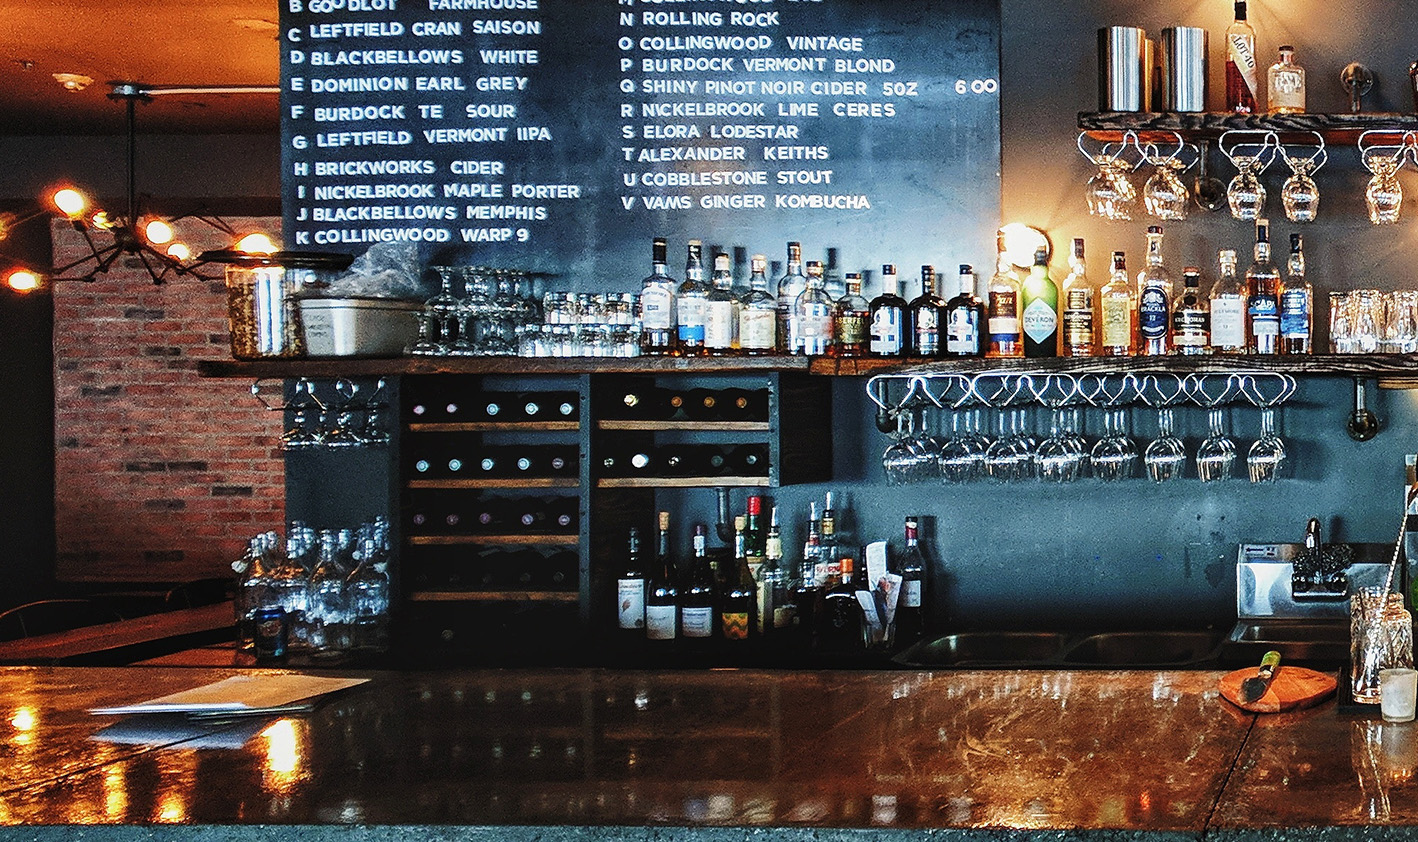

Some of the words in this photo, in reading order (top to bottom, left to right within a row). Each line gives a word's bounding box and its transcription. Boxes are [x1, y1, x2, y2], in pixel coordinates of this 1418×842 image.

[289, 0, 302, 12] B
[428, 0, 538, 11] FARMHOUSE
[619, 12, 633, 27] N
[643, 12, 722, 26] ROLLING
[731, 11, 779, 26] ROCK
[288, 28, 301, 42] C
[310, 22, 405, 38] LEFTFIELD
[412, 21, 461, 36] CRAN
[472, 21, 541, 35] SAISON
[618, 37, 632, 50] O
[639, 35, 772, 51] COLLINGWOOD
[786, 36, 863, 51] VINTAGE
[290, 51, 305, 64] D
[310, 50, 463, 65] BLACKBELLOWS
[479, 50, 538, 64] WHITE
[620, 58, 633, 72] P
[642, 58, 734, 73] BURDOCK
[742, 58, 827, 73] VERMONT
[834, 59, 895, 73] BLOND
[291, 77, 304, 91] E
[311, 77, 408, 93] DOMINION
[415, 77, 465, 91] EARL
[476, 77, 528, 91] GREY
[620, 79, 635, 94] Q
[643, 80, 698, 94] SHINY
[705, 81, 756, 95] PINOT
[761, 81, 805, 95] NOIR
[810, 81, 867, 95] CIDER
[291, 106, 304, 119] F
[314, 105, 405, 121] BURDOCK
[418, 105, 443, 119] TE
[466, 104, 516, 118] SOUR
[620, 103, 633, 117] R
[642, 103, 764, 117] NICKELBROOK
[778, 103, 818, 117] LIME
[833, 103, 896, 117] CERES
[293, 136, 308, 149] G
[317, 131, 412, 147] LEFTFIELD
[423, 128, 508, 144] VERMONT
[517, 127, 552, 142] IIPA
[622, 125, 634, 139] S
[643, 125, 700, 139] ELORA
[710, 125, 799, 138] LODESTAR
[622, 147, 634, 161] T
[638, 147, 745, 162] ALEXANDER
[763, 146, 828, 160] KEITHS
[294, 162, 308, 176] H
[315, 160, 435, 175] BRICKWORKS
[450, 161, 504, 175] CIDER
[624, 173, 635, 187] U
[641, 171, 768, 187] COBBLESTONE
[777, 170, 832, 184] STOUT
[314, 184, 435, 200] NICKELBROOK
[443, 183, 504, 198] MAPLE
[512, 184, 582, 199] PORTER
[621, 196, 635, 210] V
[642, 196, 692, 210] VAMS
[700, 195, 766, 209] GINGER
[775, 194, 870, 210] KOMBUCHA
[297, 208, 308, 221] J
[313, 206, 457, 221] BLACKBELLOWS
[466, 206, 547, 220] MEMPHIS
[296, 232, 309, 245] K
[314, 228, 450, 243] COLLINGWOOD
[461, 228, 512, 242] WARP
[516, 228, 528, 242] 9
